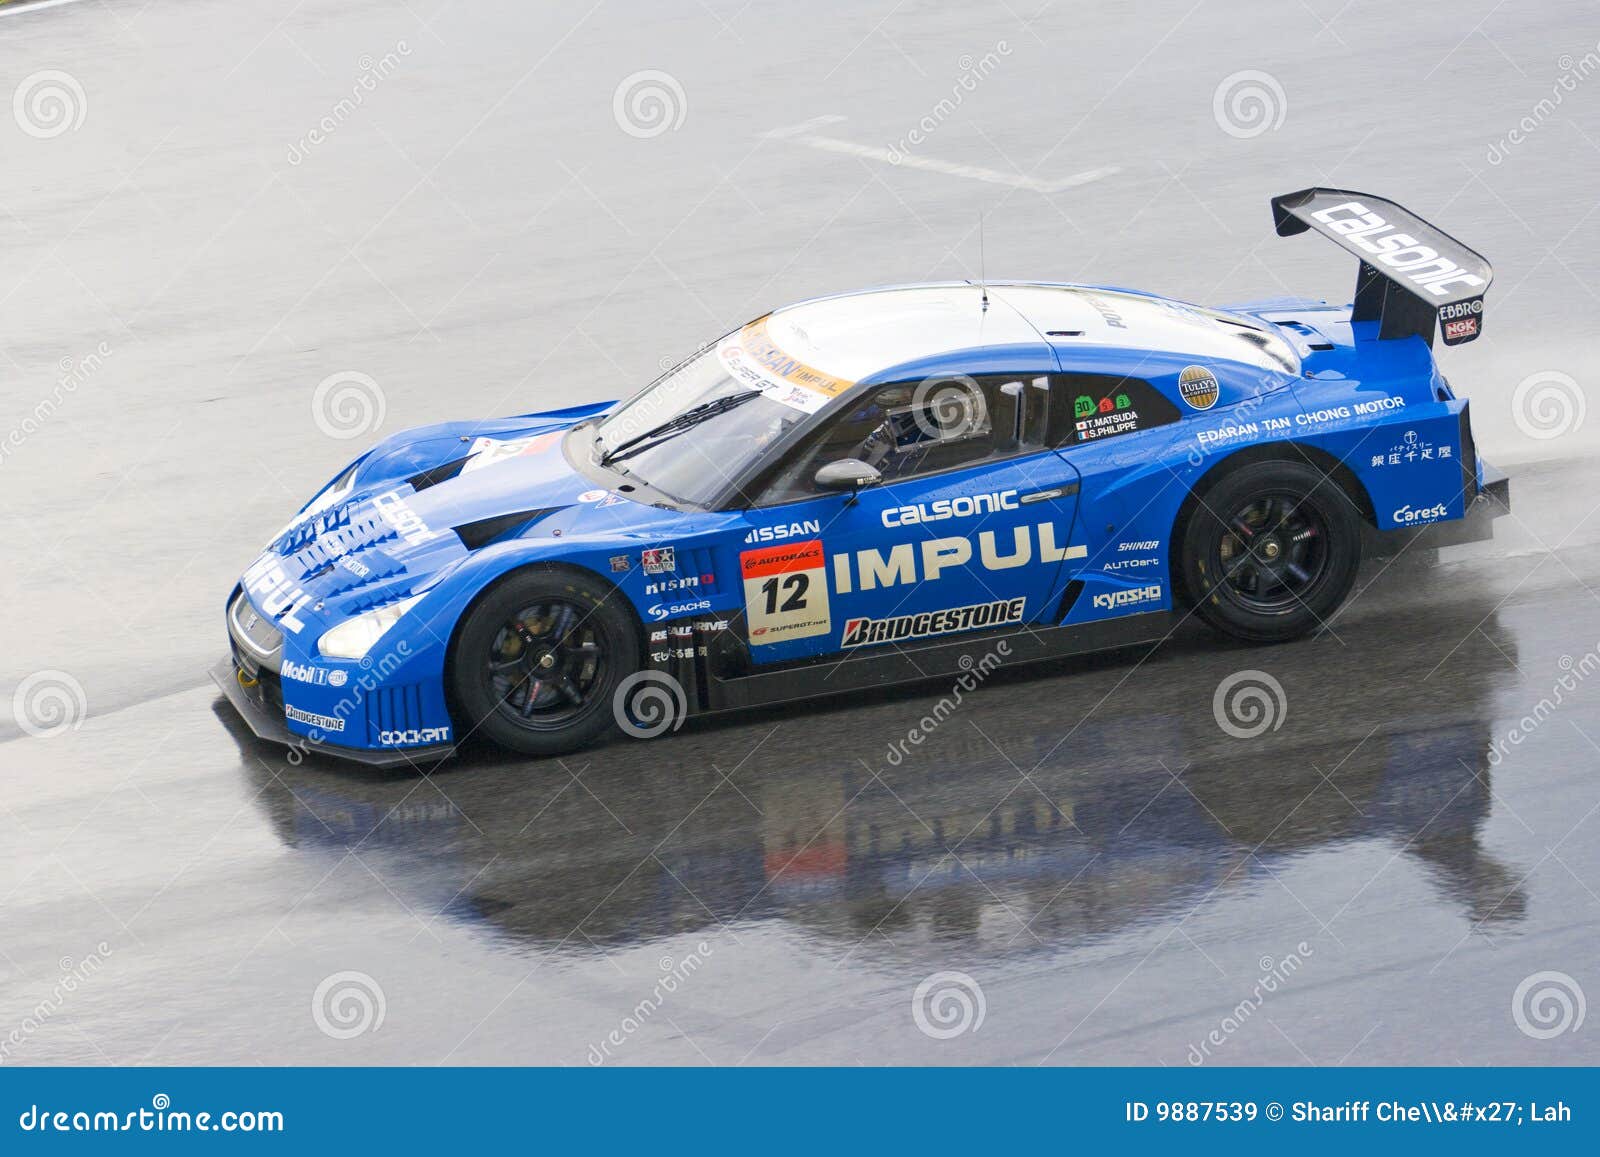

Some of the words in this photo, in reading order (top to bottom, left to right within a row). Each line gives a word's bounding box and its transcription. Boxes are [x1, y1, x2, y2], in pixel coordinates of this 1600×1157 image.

[1439, 300, 1483, 320] EBBRO
[1447, 319, 1475, 336] NGK
[1075, 401, 1090, 413] 30
[1086, 411, 1138, 428] T.MATSUDA
[1196, 423, 1258, 444] EDARAN
[1262, 417, 1291, 431] TAN
[1295, 407, 1351, 425] CHONG
[1353, 396, 1406, 415] MOTOR
[1089, 421, 1137, 438] S.PHILIPPE
[1393, 503, 1447, 523] Carest
[758, 549, 820, 566] AUTOBACS
[833, 522, 1087, 594] IMPUL
[1103, 558, 1160, 571] AUTOart
[762, 573, 809, 615] 12
[670, 600, 711, 614] SACHS
[842, 598, 1025, 648] BRIDGESTONE
[281, 659, 315, 684] Mobil
[285, 704, 345, 731] BRIDGESTONE
[378, 727, 449, 745] COCKPIT
